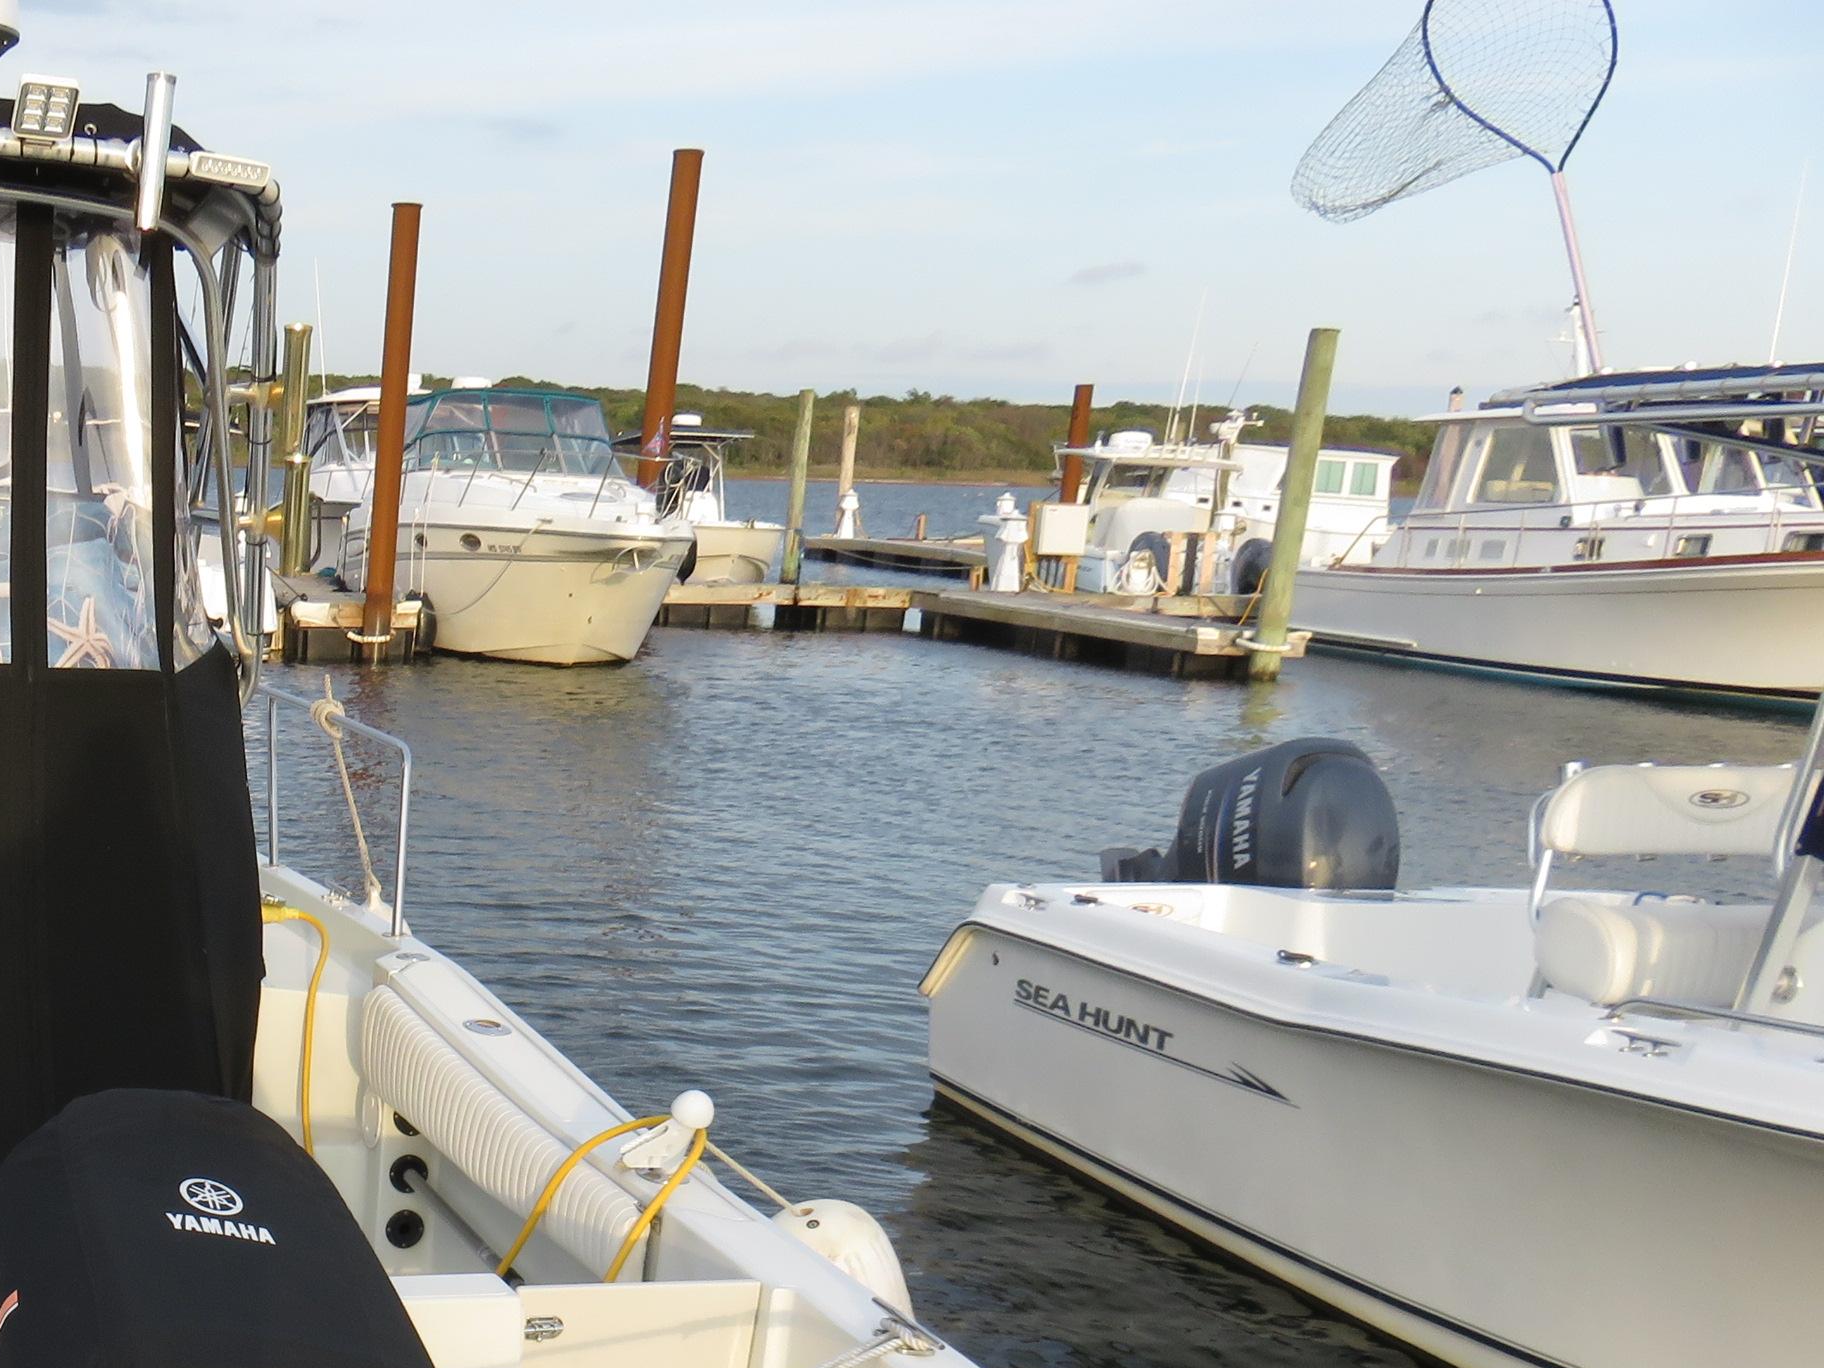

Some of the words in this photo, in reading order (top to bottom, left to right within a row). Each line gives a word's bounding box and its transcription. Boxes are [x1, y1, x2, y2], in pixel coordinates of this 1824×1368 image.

[1232, 766, 1262, 870] YAMAHA
[1015, 979, 1072, 1018] SEA
[1078, 1001, 1174, 1051] HUNT
[165, 1212, 277, 1246] YAMAHA
